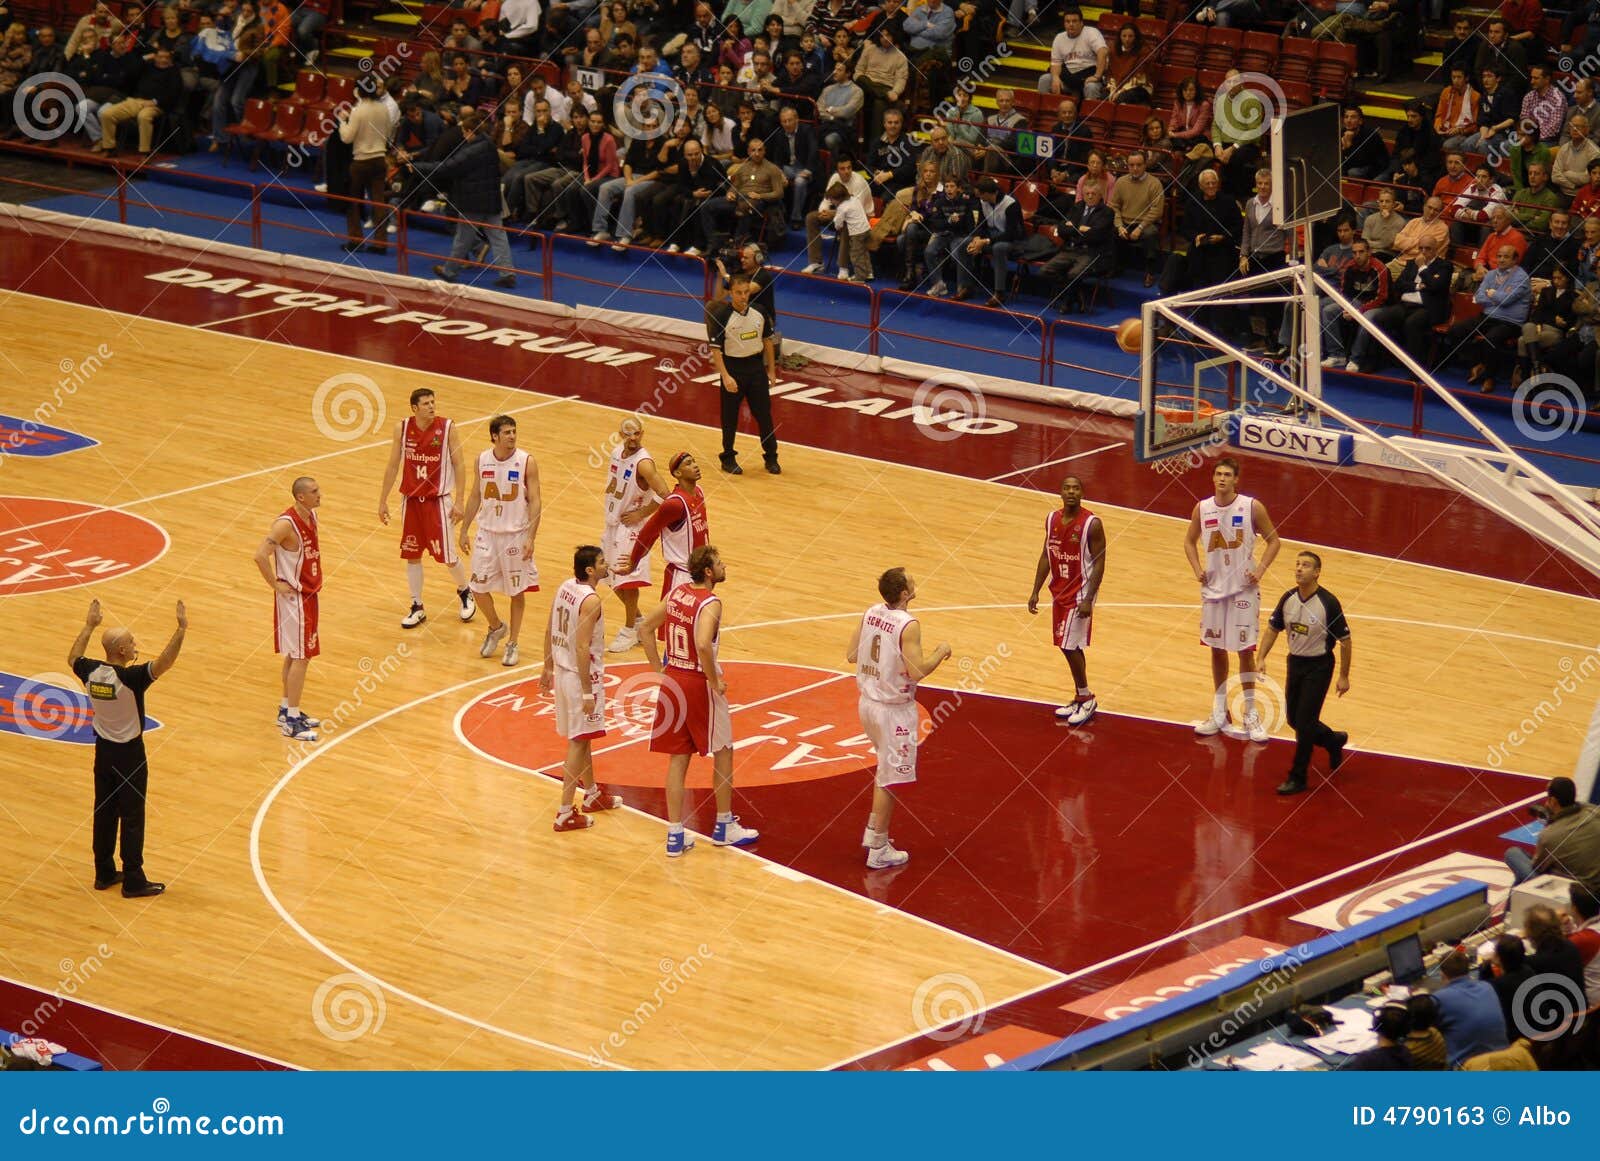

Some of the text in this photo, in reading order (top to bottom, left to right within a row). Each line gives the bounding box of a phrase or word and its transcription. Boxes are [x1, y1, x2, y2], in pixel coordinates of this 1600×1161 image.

[1020, 135, 1049, 154] A 5
[144, 268, 392, 318] DATCH
[373, 311, 656, 367] FORUM
[1244, 423, 1334, 456] SONY
[406, 452, 441, 464] Whirlpool
[416, 465, 428, 480] 14
[484, 481, 519, 501] AJ
[1207, 529, 1244, 552] AJ
[1059, 563, 1070, 580] 12
[668, 622, 690, 660] 10
[870, 634, 882, 664] 6
